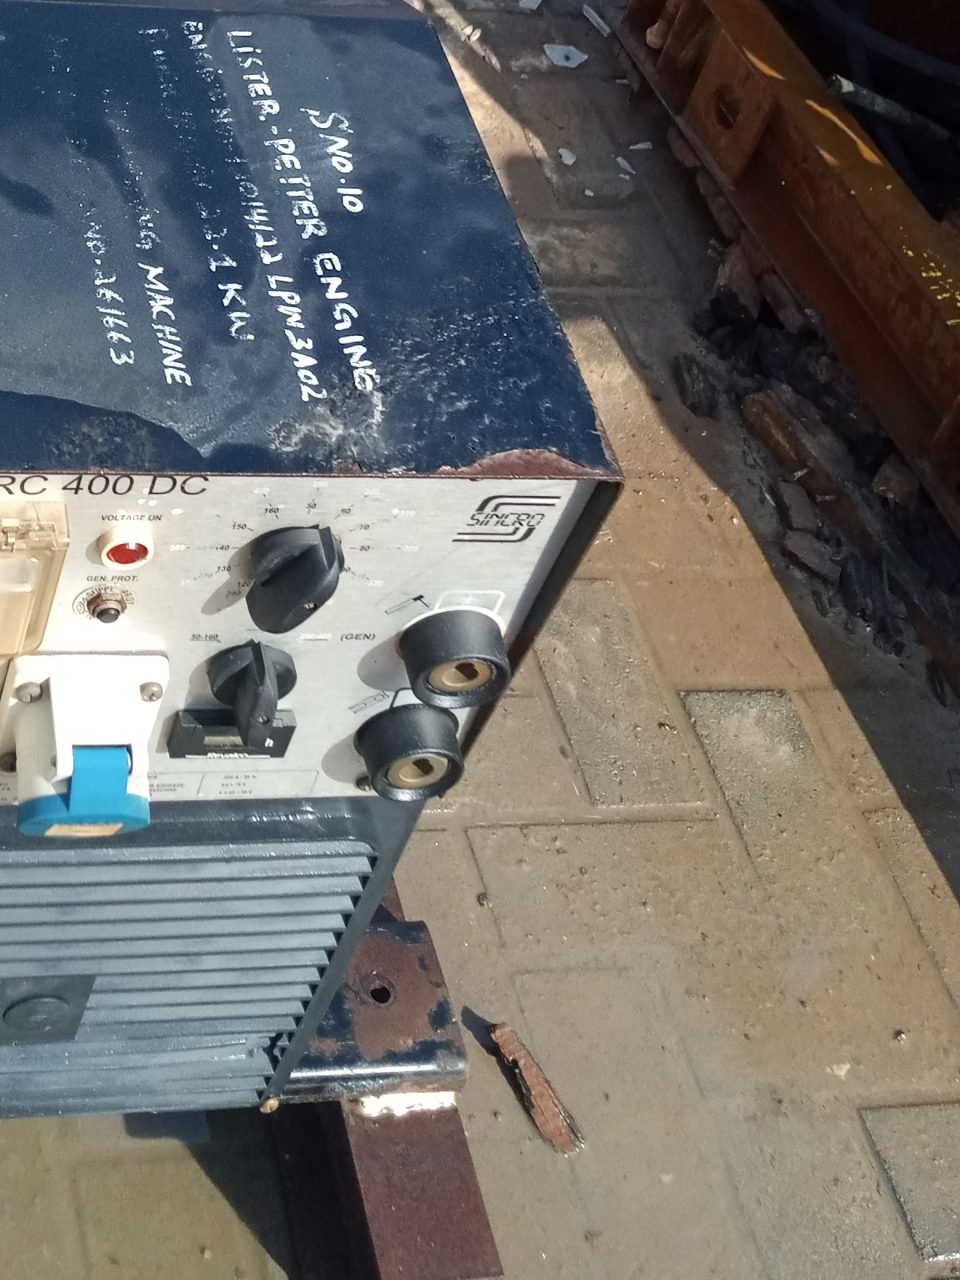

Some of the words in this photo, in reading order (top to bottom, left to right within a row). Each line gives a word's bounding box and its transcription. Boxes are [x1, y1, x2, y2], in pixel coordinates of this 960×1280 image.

[137, 262, 193, 387] MACHINE
[313, 252, 376, 392] ENGINE
[61, 475, 134, 496] 400
[148, 475, 210, 495] DC
[465, 512, 546, 528] SINCRO
[340, 632, 376, 642] (GEN)
